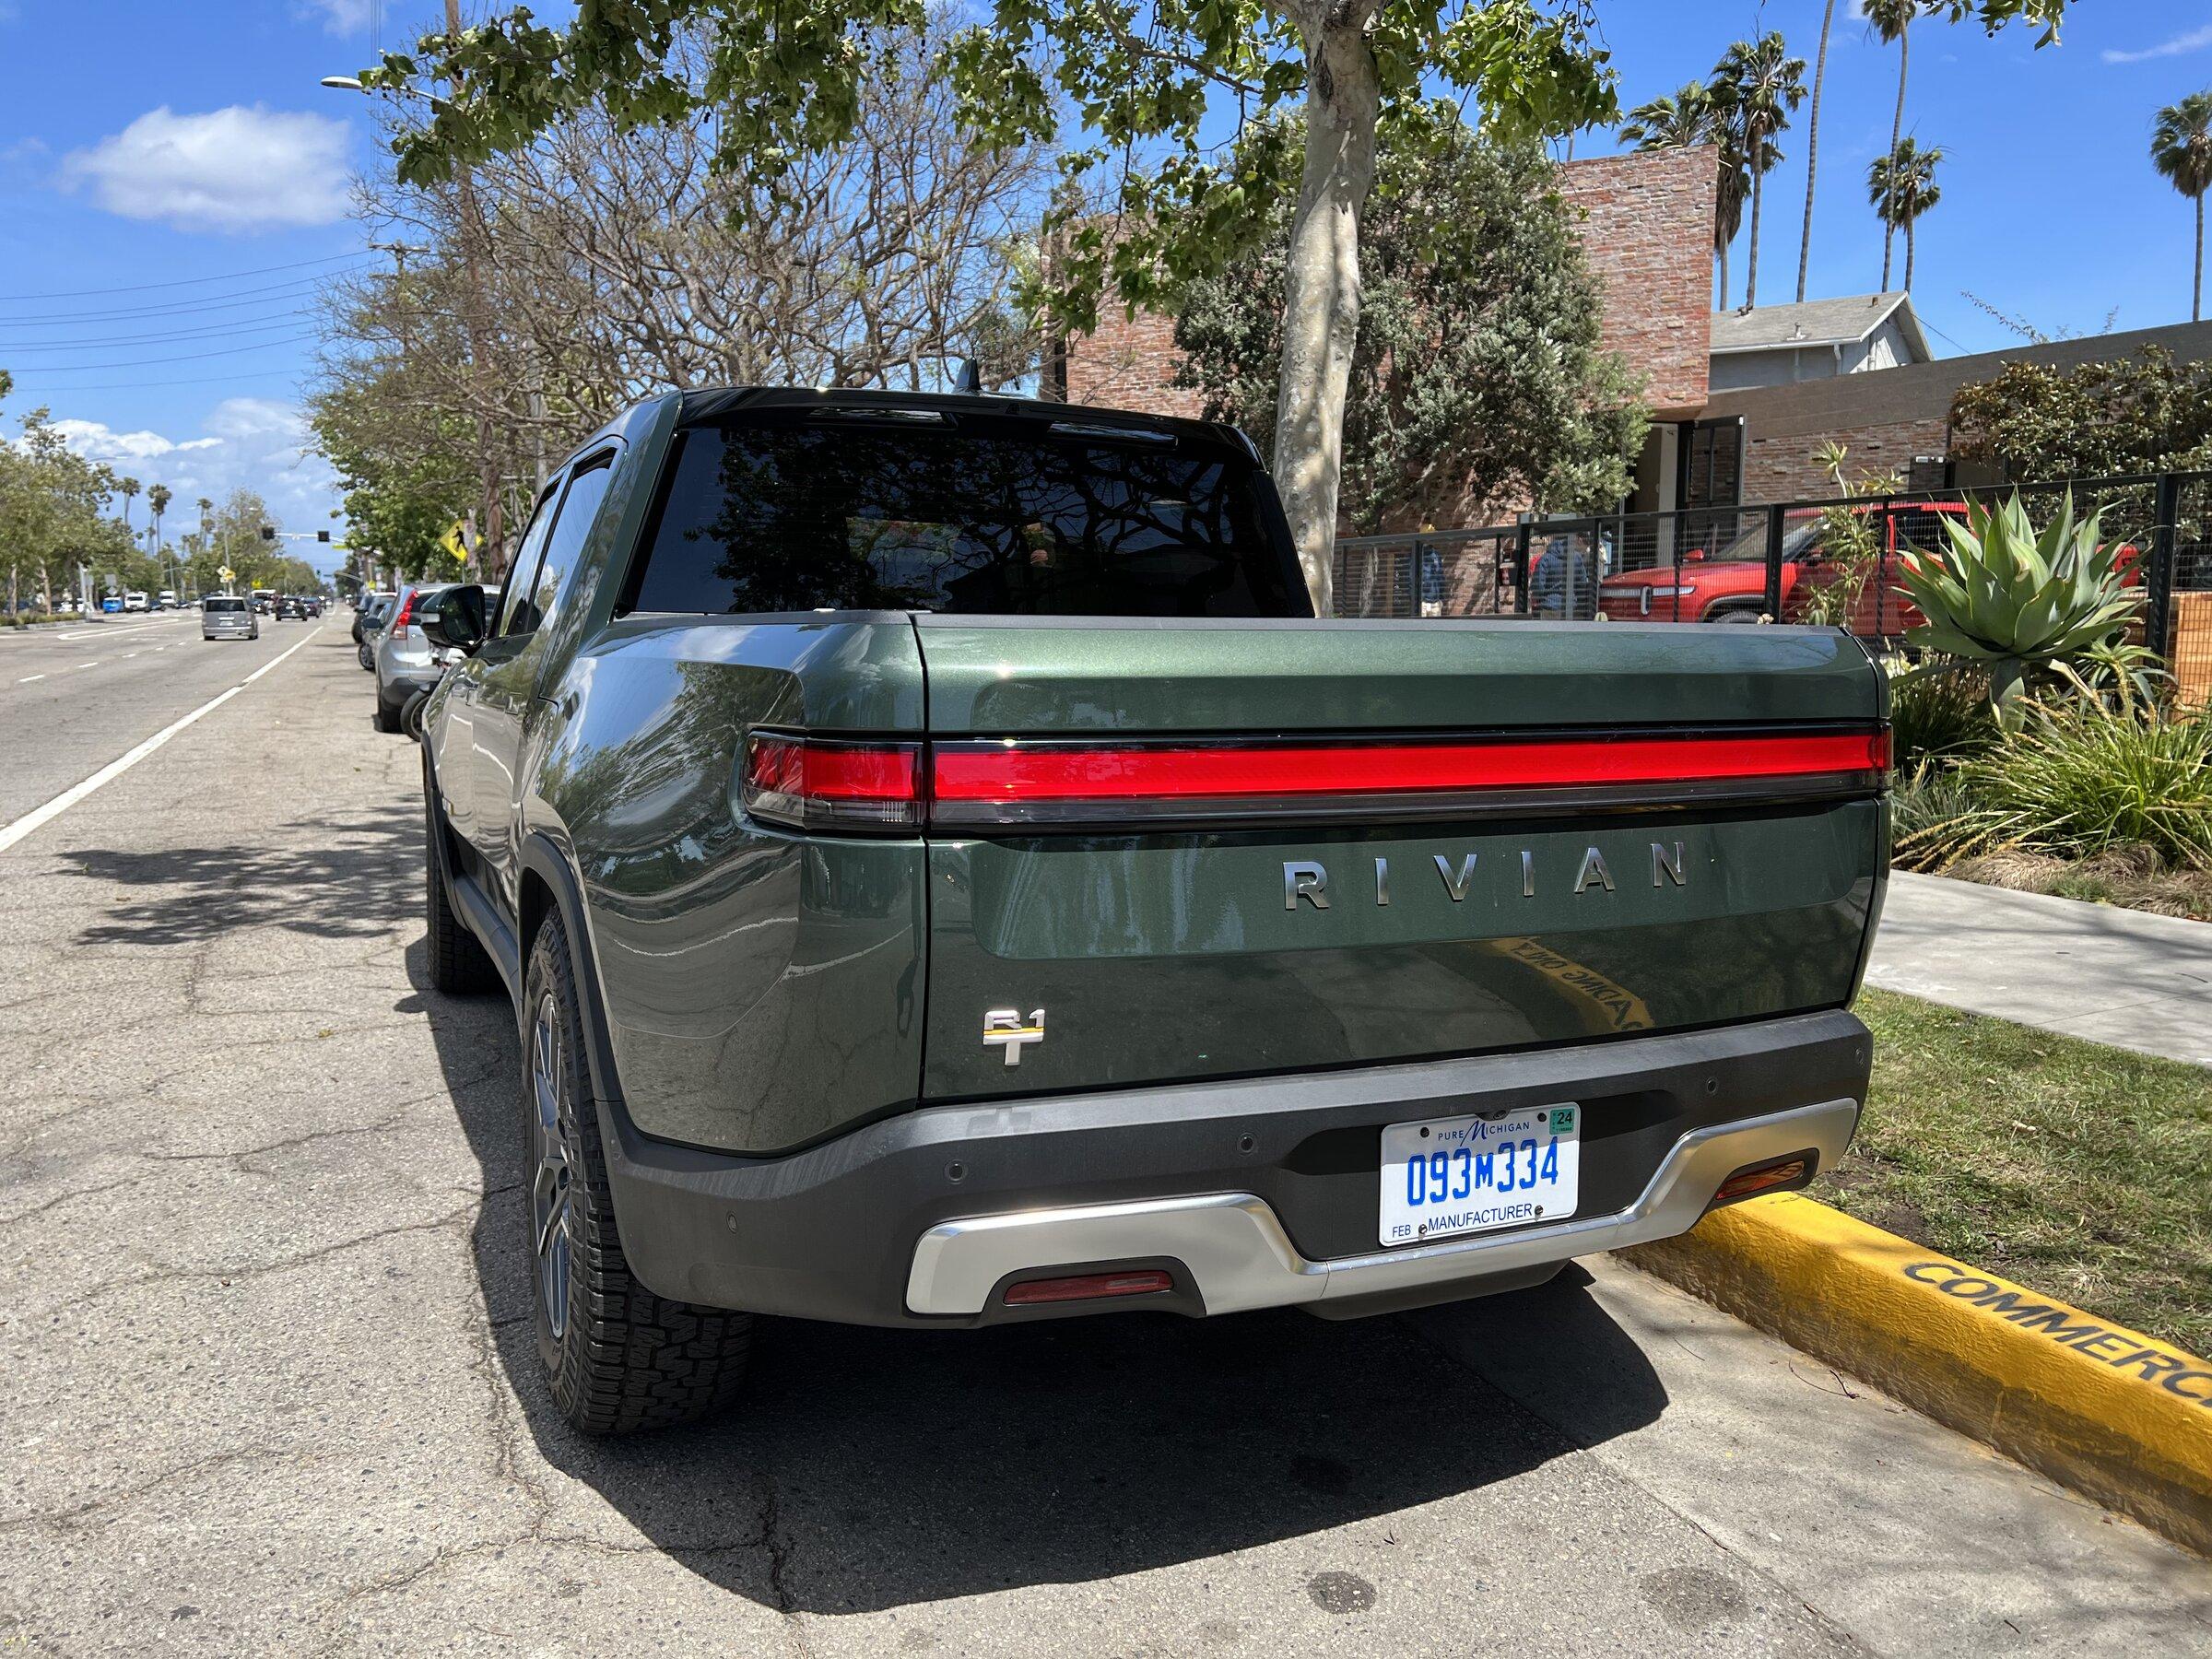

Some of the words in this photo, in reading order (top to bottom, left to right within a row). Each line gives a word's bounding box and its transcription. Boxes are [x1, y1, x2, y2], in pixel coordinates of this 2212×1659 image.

[1282, 841, 1687, 911] RIVIAN
[1438, 1130, 1464, 1141] PURE
[1460, 1120, 1530, 1147] MICHIGAN
[1556, 1111, 1572, 1125] 24
[1406, 1135, 1559, 1206] 093M334
[1392, 1224, 1411, 1238] FEB
[1428, 1203, 1533, 1232] MANUFACTURER
[1903, 1263, 2212, 1406] COMMERC
